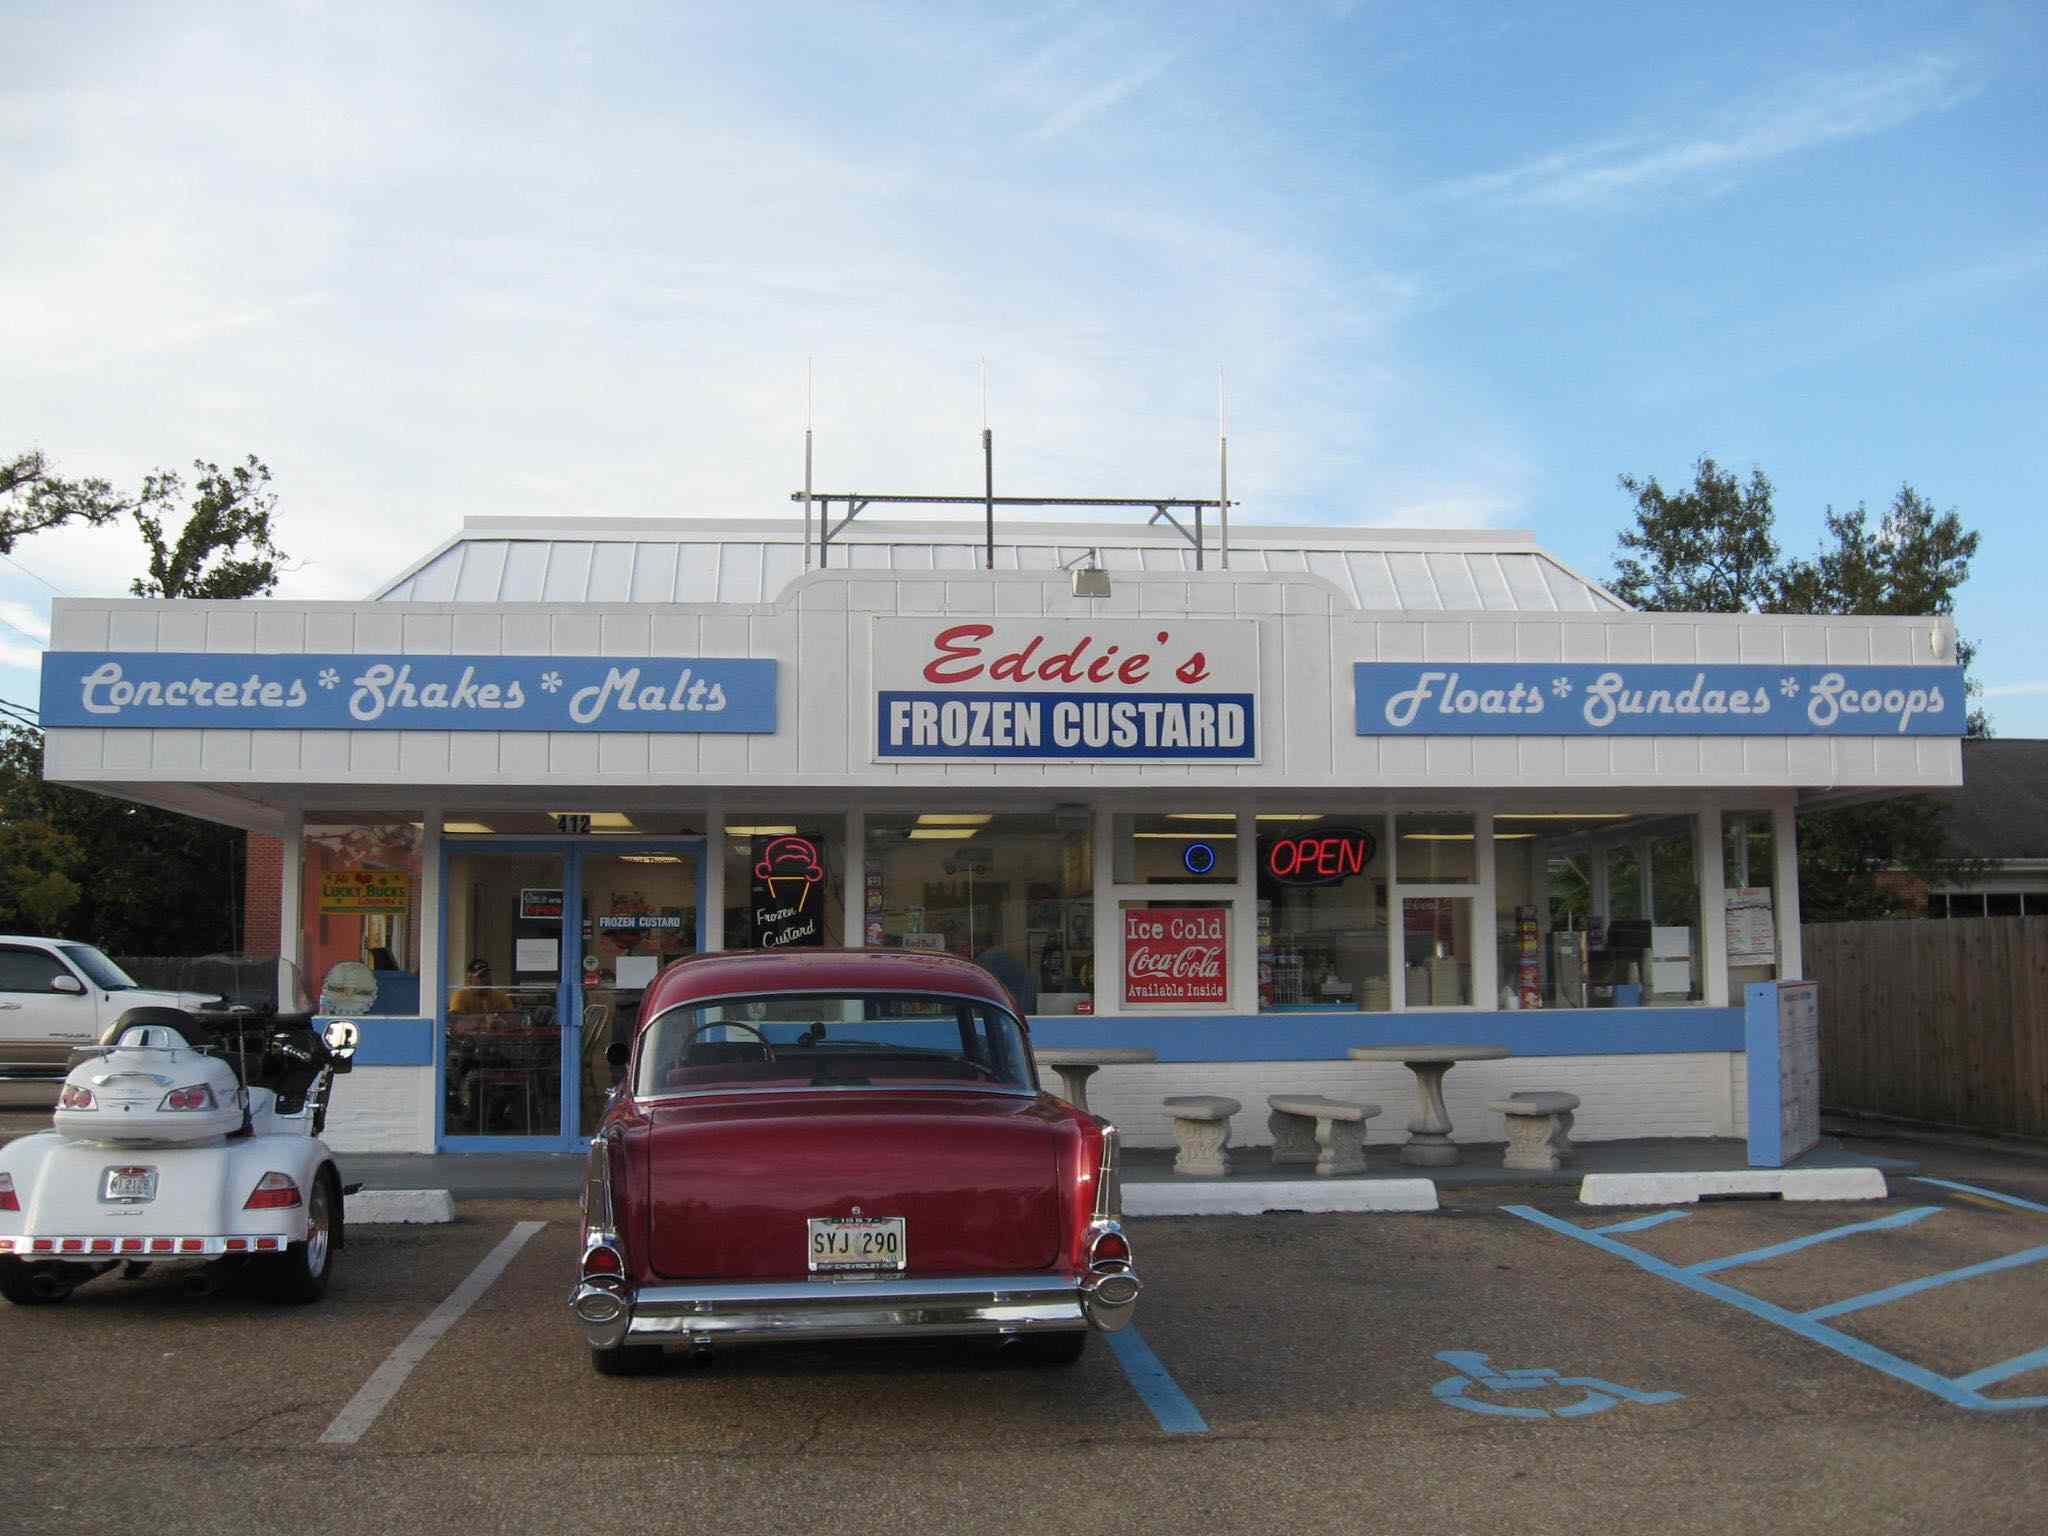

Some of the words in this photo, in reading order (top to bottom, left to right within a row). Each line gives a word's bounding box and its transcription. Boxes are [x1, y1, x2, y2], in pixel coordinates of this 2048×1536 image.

[923, 624, 1212, 685] Eddie's
[81, 662, 307, 714] Concretes
[350, 664, 525, 721] Shakes
[569, 666, 727, 724] Malts
[1385, 672, 1545, 727] Floats
[1583, 672, 1771, 727] Sundaes
[1807, 672, 1945, 732] Scoops
[889, 701, 1041, 747] FROZEN
[1052, 701, 1245, 748] CUSTARD
[558, 815, 591, 833] 412
[1269, 838, 1365, 875] OPEN
[600, 916, 635, 927] FROZEN
[639, 916, 680, 927] CUSTARD
[756, 907, 797, 925] Frozen
[1127, 918, 1164, 939] Ice
[1171, 918, 1223, 939] Cold
[762, 919, 816, 949] Custard
[1128, 946, 1223, 978] Coca-Cola
[1129, 984, 1184, 997] Available
[1187, 984, 1224, 997] Inside
[814, 1232, 849, 1254] SYJ
[863, 1232, 897, 1254] 290
